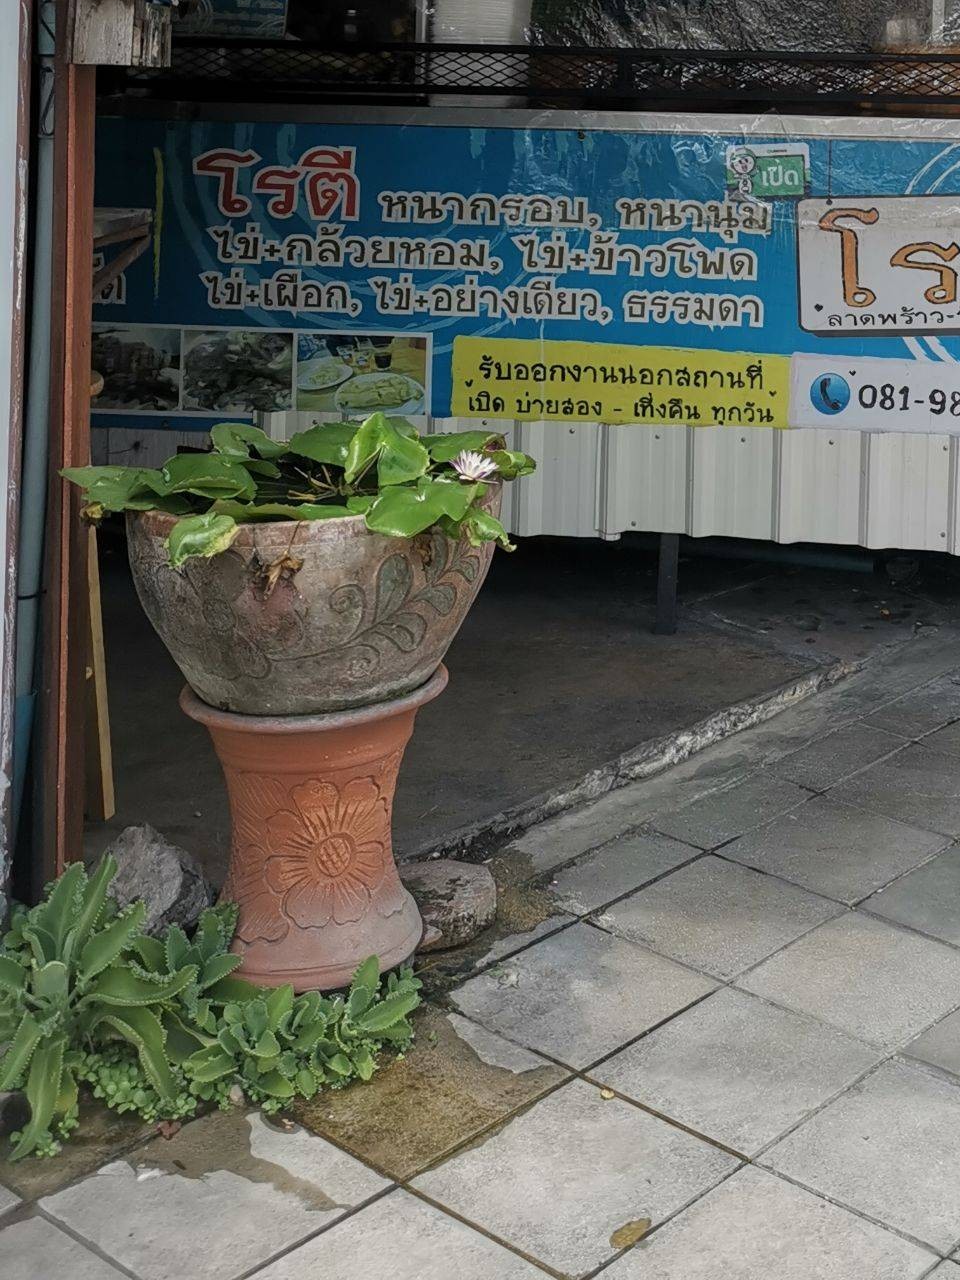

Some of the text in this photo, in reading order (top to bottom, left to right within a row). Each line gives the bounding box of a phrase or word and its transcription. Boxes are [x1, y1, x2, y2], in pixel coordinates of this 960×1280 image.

[195, 147, 358, 219] โรตี
[628, 294, 761, 323] ธรรมดา
[478, 355, 764, 390] รับออกงานนอกสถานที่
[467, 392, 506, 414] เปิด
[515, 392, 602, 416] บ่ายสอง
[711, 401, 774, 425] ทุกวัน
